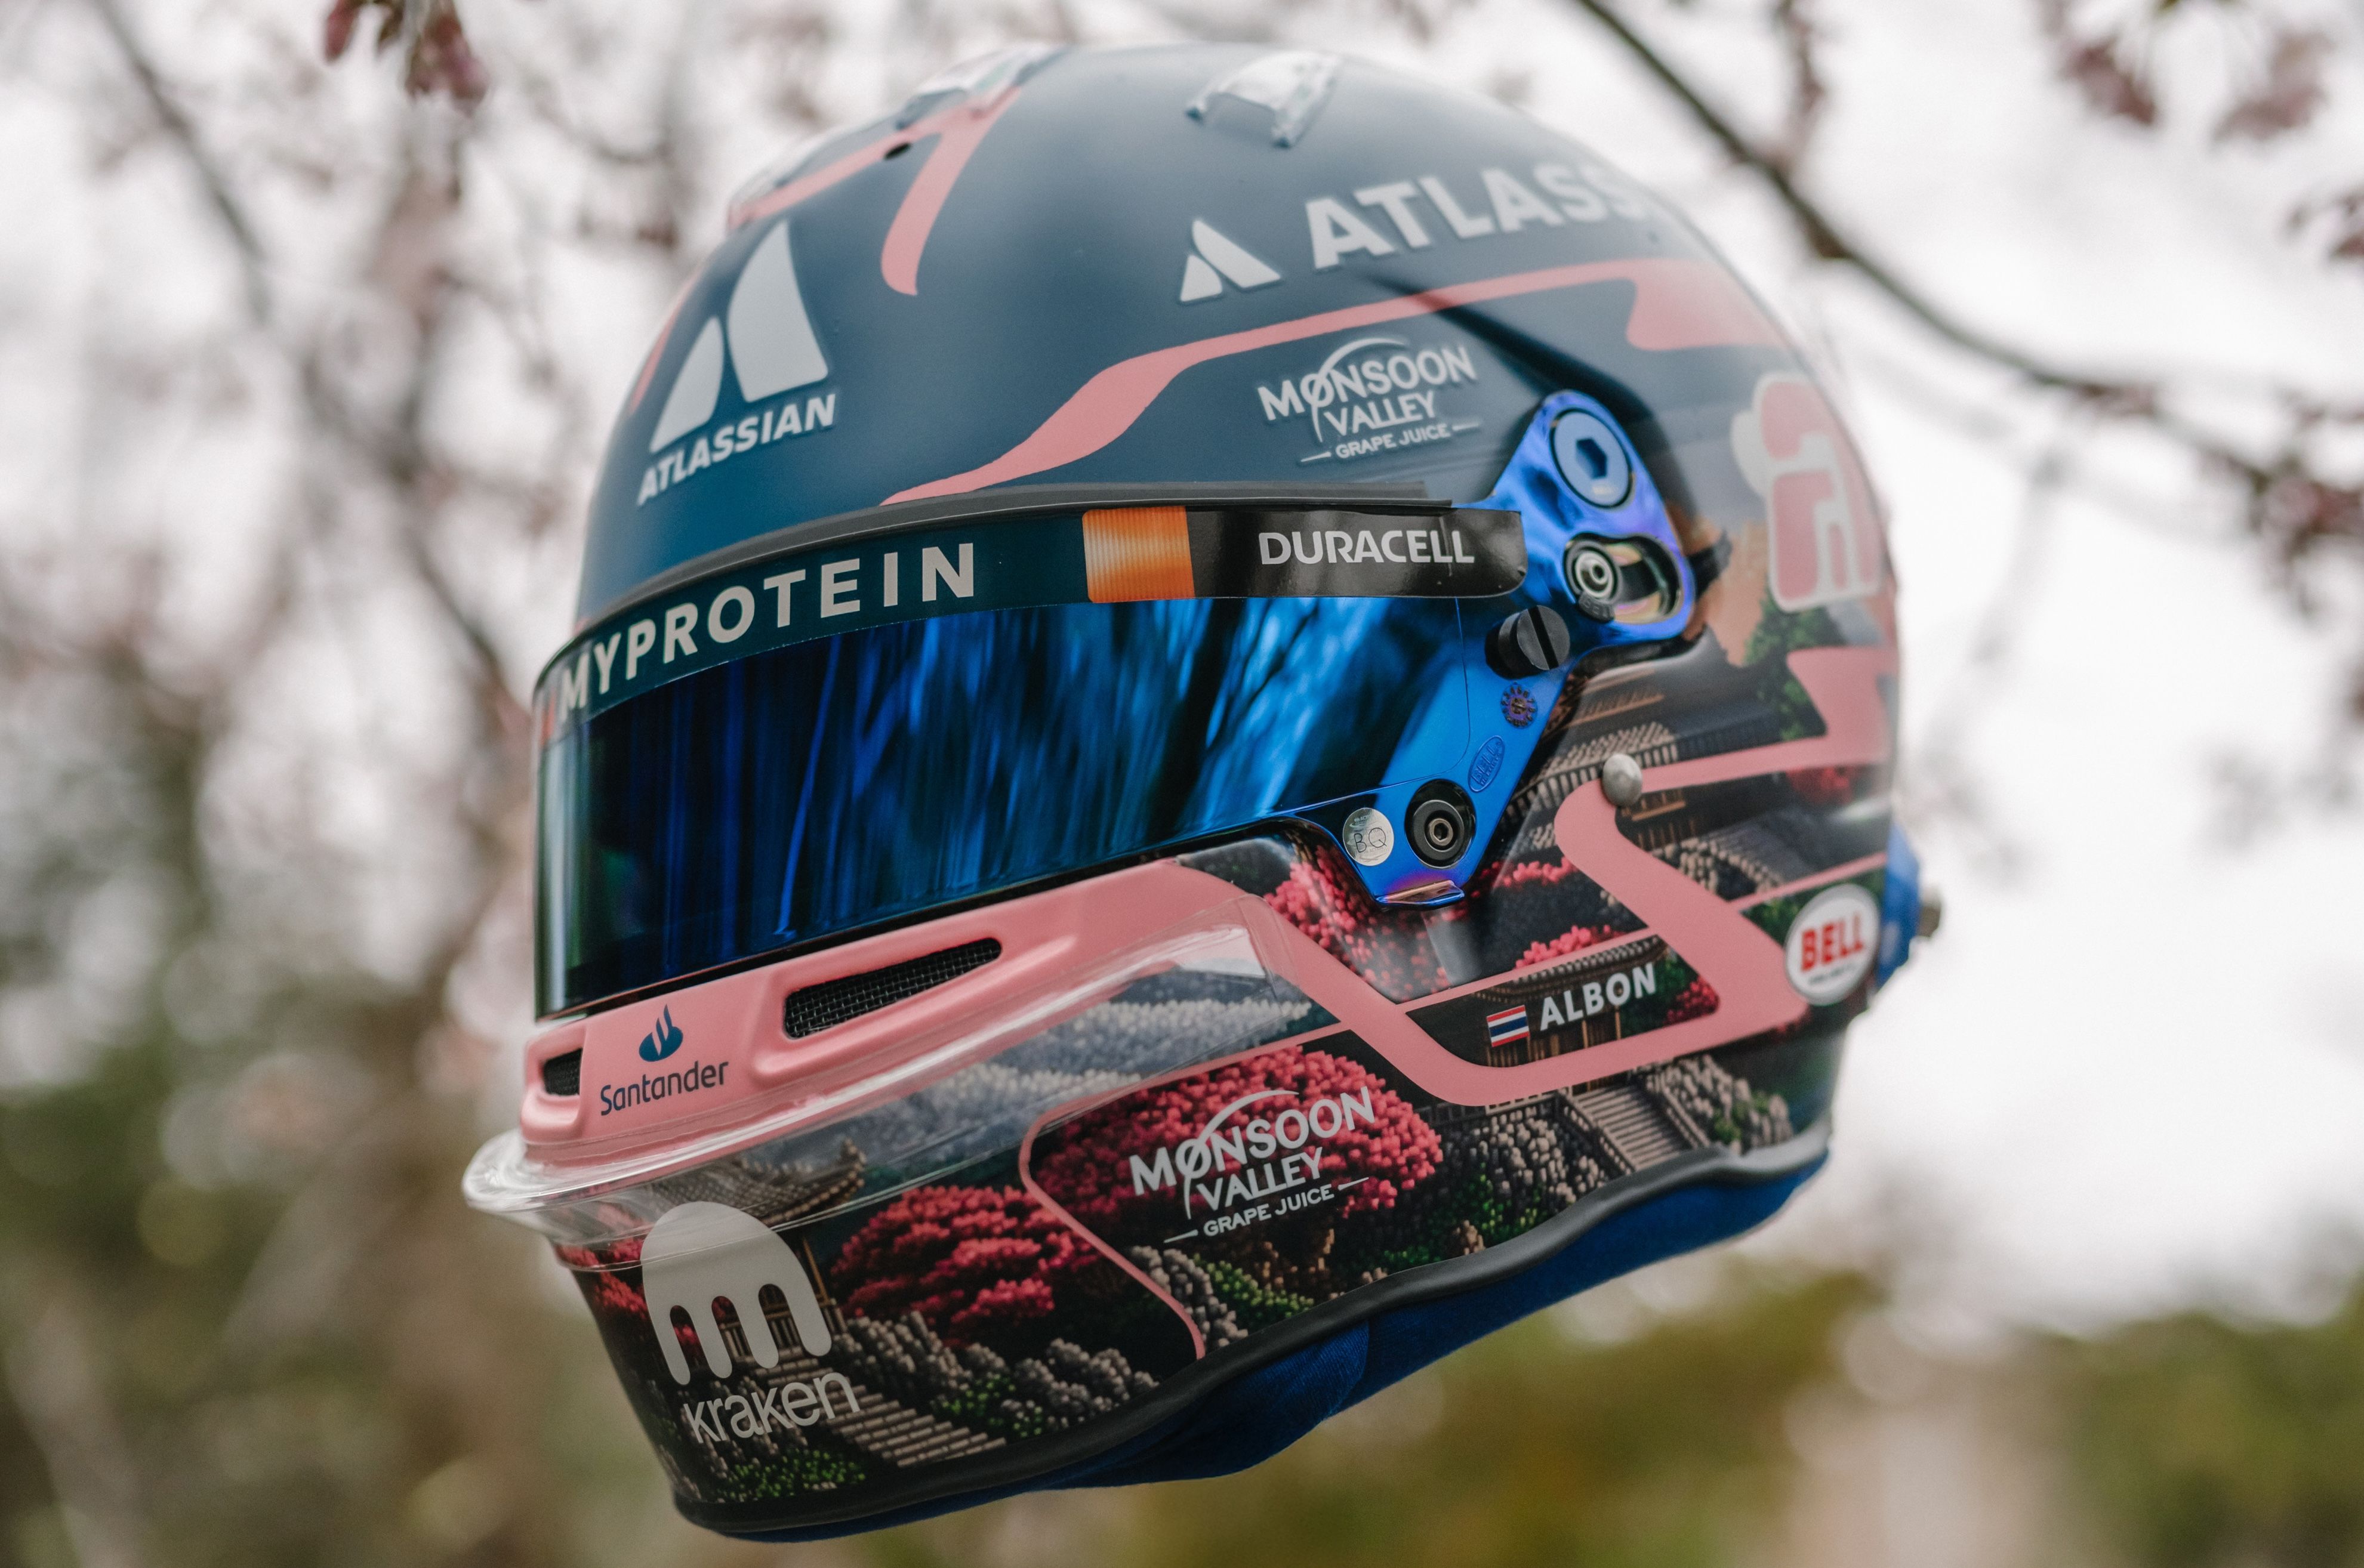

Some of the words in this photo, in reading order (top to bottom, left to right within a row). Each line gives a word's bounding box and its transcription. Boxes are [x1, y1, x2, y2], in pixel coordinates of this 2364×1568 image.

[1257, 346, 1478, 421] MONSOON
[1323, 390, 1435, 436] VALLEY
[636, 393, 837, 505] ATLASSIAN
[1335, 433, 1397, 459] GRAPE
[1399, 423, 1451, 446] JUICE
[1258, 529, 1475, 565] DURACELL
[559, 542, 974, 722] MYPROTEIN
[1801, 911, 1864, 973] BELL
[1540, 962, 1657, 1032] ALBON
[600, 1060, 729, 1116] Santander
[1128, 1085, 1376, 1196] MONSOON
[1197, 1146, 1323, 1211] VALLEY
[1203, 1203, 1272, 1237] GRAPE
[1275, 1183, 1335, 1216] JUICE
[683, 1372, 861, 1444] kraken
